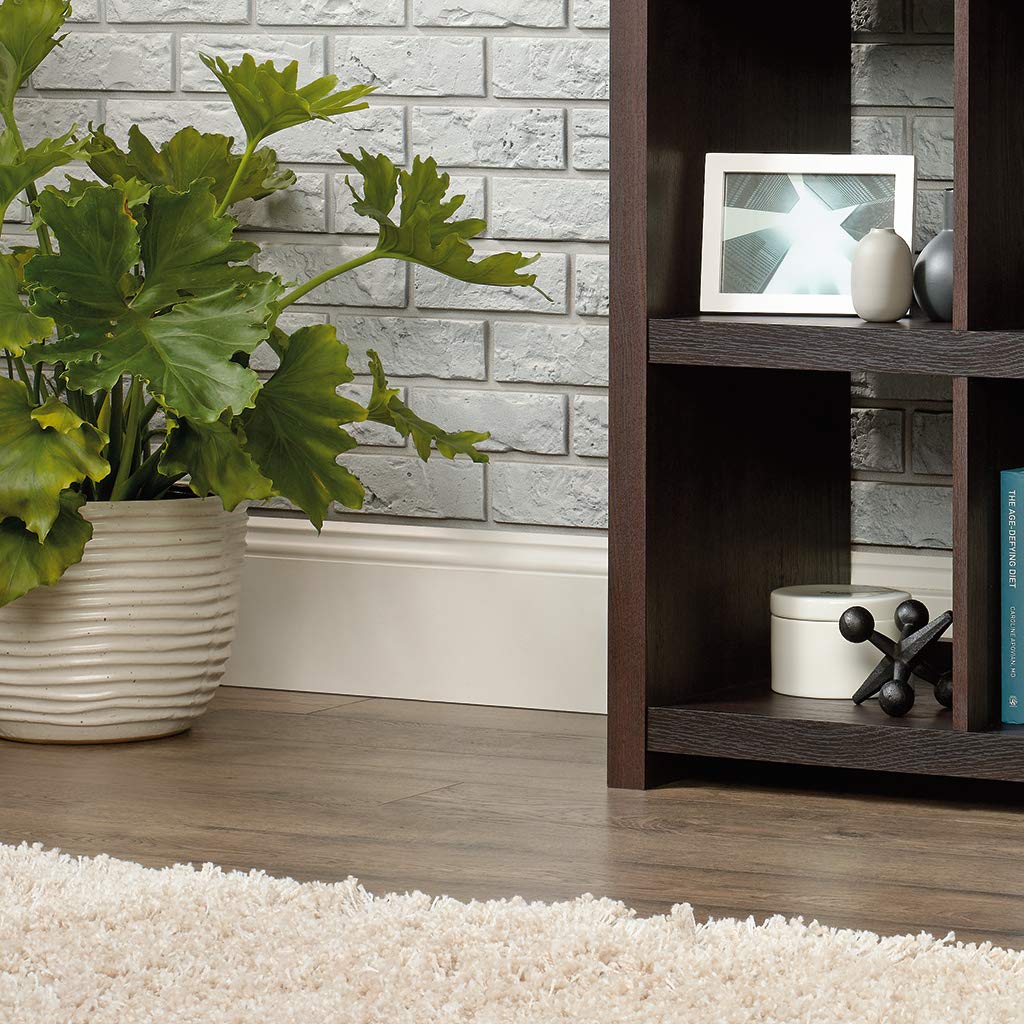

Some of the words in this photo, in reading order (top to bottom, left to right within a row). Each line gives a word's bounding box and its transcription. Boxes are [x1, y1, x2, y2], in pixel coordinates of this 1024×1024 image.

[1008, 490, 1016, 507] THE
[1008, 509, 1017, 567] AGE-DEFYING
[1008, 568, 1017, 589] DIET
